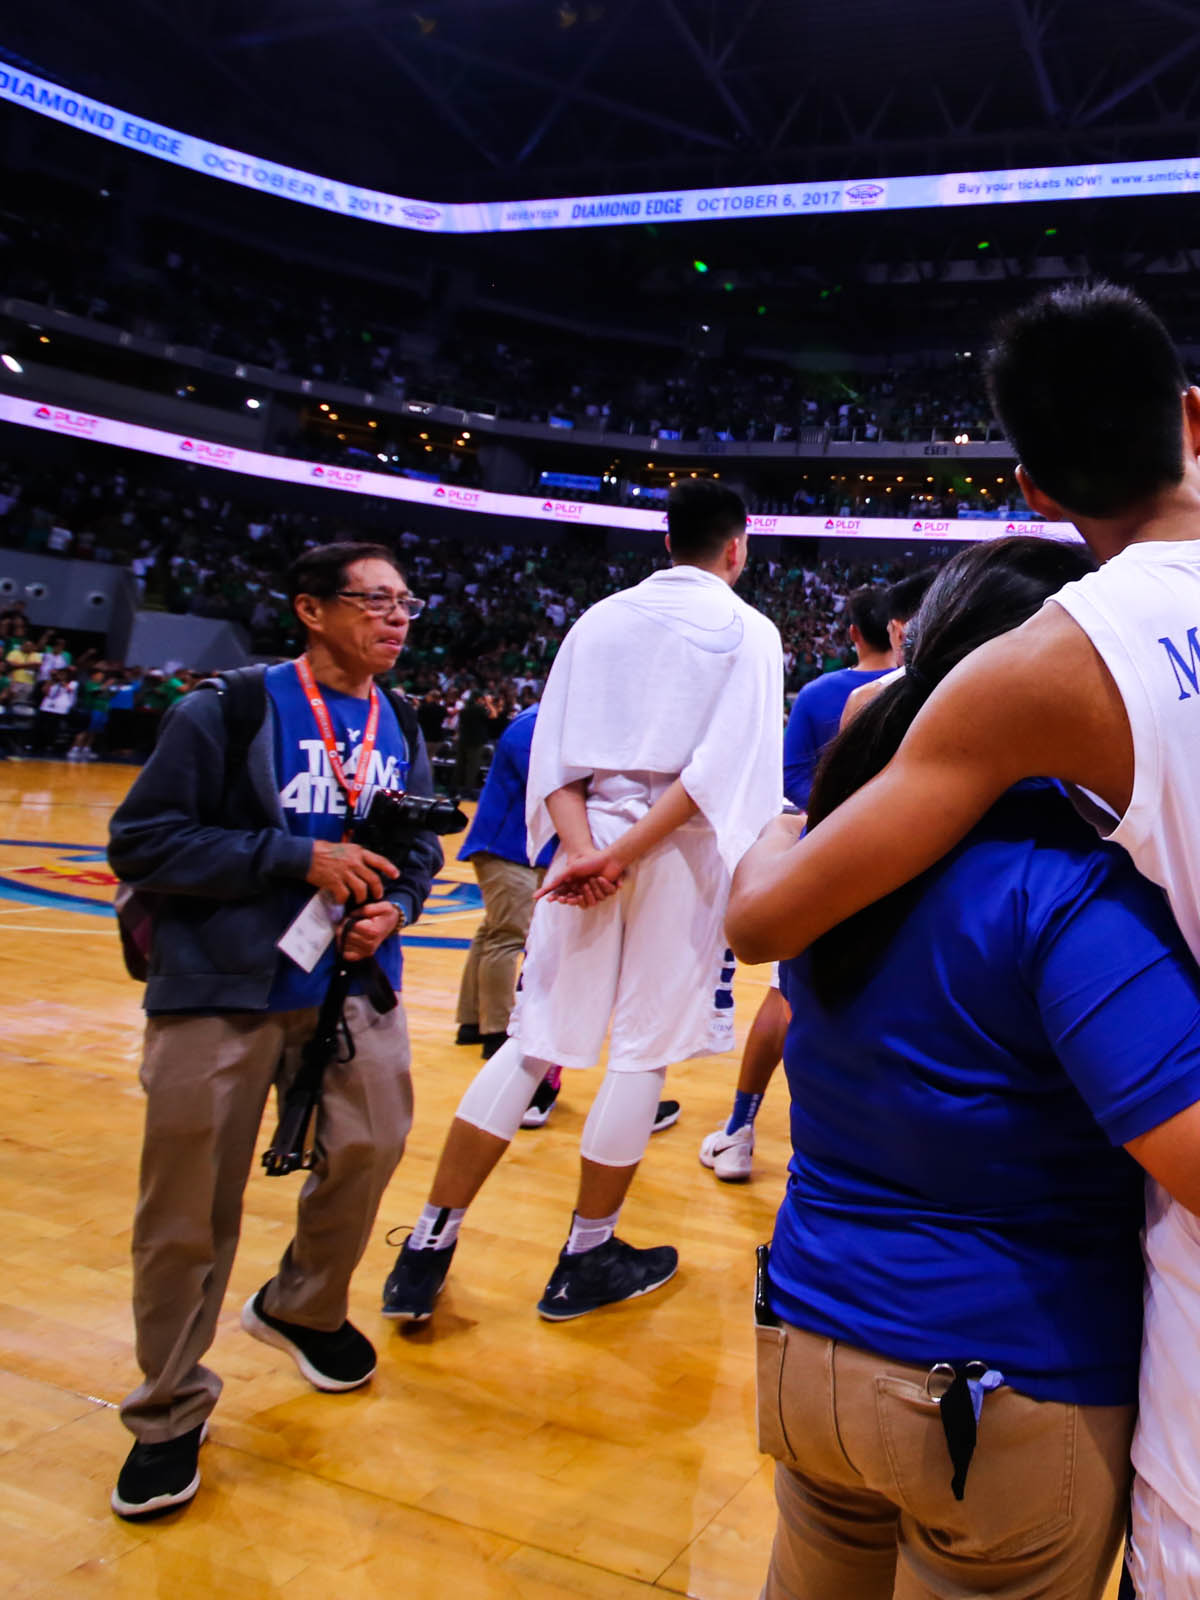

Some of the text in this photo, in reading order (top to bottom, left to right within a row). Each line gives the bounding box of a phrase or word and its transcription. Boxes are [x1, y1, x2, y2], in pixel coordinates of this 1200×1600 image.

[0, 71, 182, 156] DIAMOND EDGE
[202, 152, 317, 198] OCTOBER
[348, 195, 393, 216] 2017
[957, 182, 982, 194] Buy
[985, 182, 1013, 194] your
[1018, 178, 1061, 190] tickets
[571, 200, 641, 219] DIAMOND
[645, 197, 684, 215] EDGE
[696, 194, 777, 212] OCTOBER
[802, 191, 841, 206] 2017
[55, 411, 97, 428] PLDT
[197, 444, 235, 459] PLDT
[328, 470, 362, 482] PLDT
[448, 490, 480, 501] PLDT
[555, 503, 584, 514] PLDT
[754, 518, 778, 527] PLDT
[836, 520, 860, 529] PLDT
[924, 522, 951, 531] PLDT
